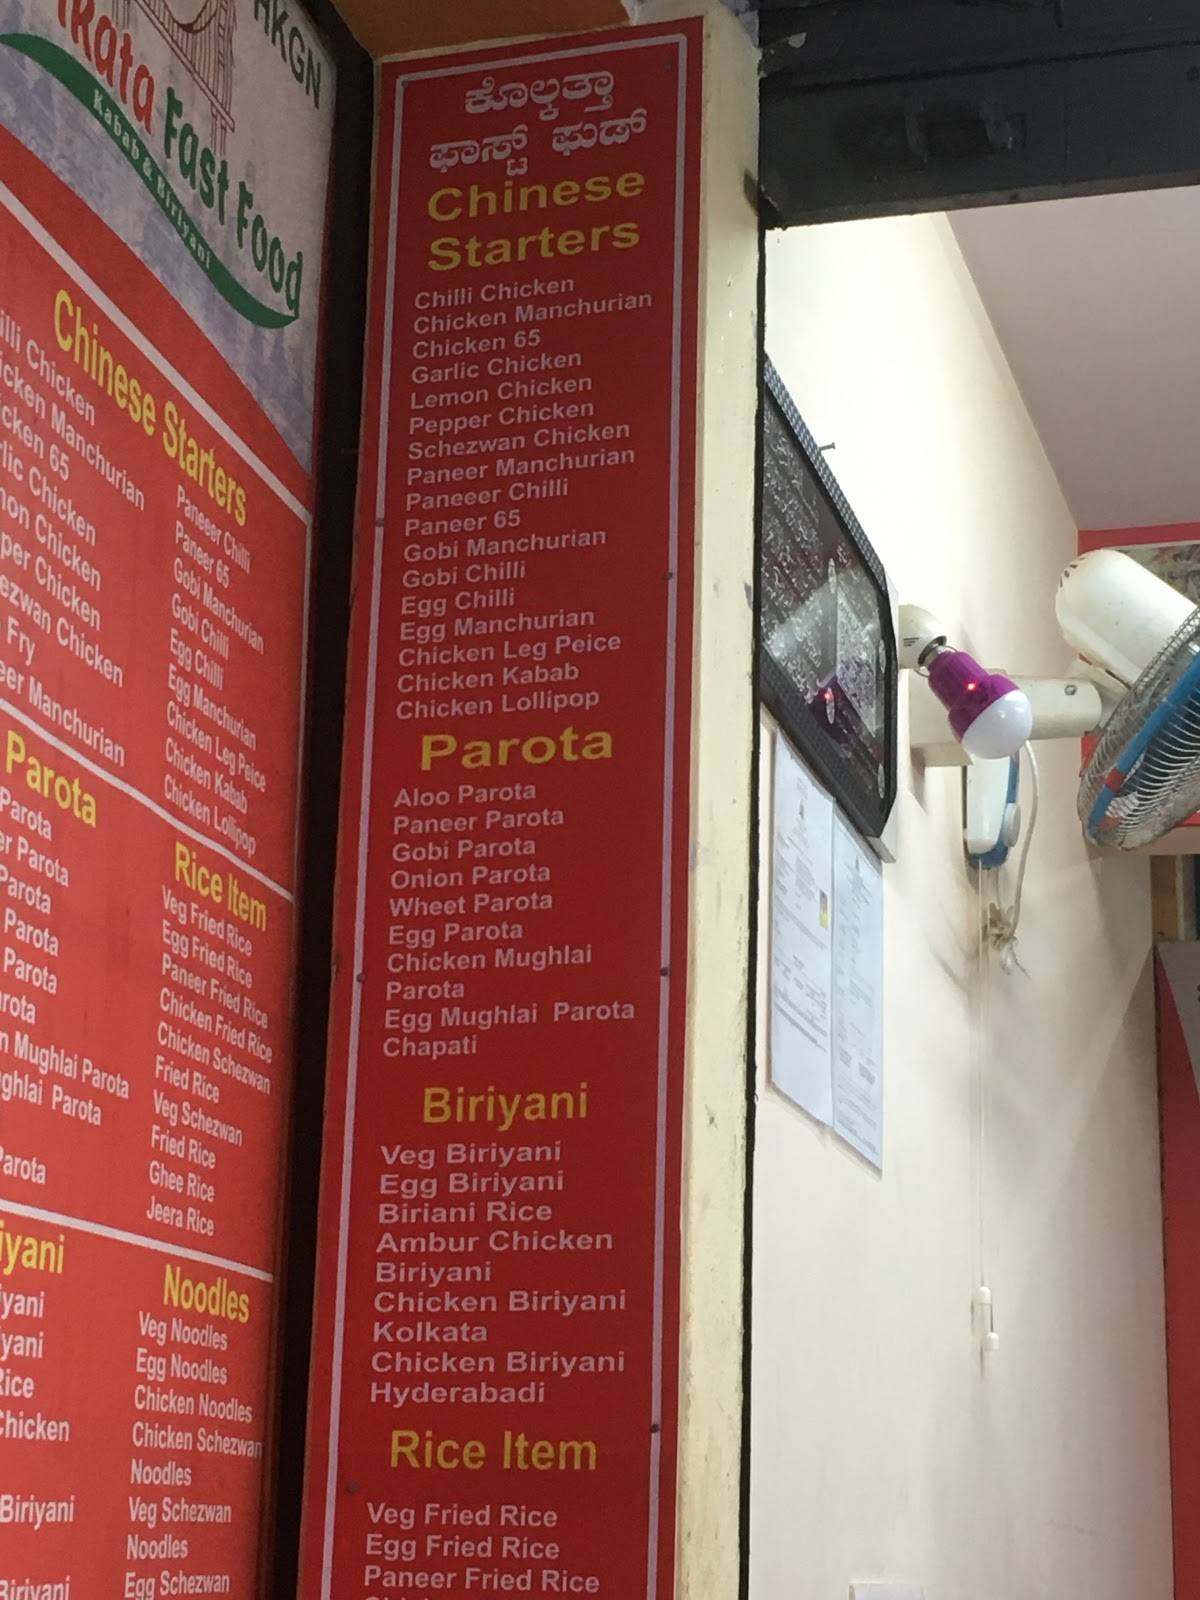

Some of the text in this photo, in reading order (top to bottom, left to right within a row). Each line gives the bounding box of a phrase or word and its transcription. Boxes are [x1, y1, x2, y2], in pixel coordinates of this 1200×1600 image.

[164, 87, 302, 319] Fast Food
[428, 171, 645, 222] Chinese
[428, 221, 640, 271] Starters
[414, 279, 574, 309] Chilli Chicken
[413, 293, 652, 334] Chicken Manchurian
[412, 329, 541, 359] Chicken 65
[27, 340, 95, 426] Chicken
[411, 353, 582, 384] Garlic Chicken
[54, 289, 246, 526] Chinese Starters
[411, 377, 592, 410] Lemon Chicken
[410, 402, 594, 435] Pepper Chicken
[51, 405, 144, 511] Manchurian
[408, 424, 630, 460] Schezwan Chicken
[50, 444, 69, 481] 65
[407, 449, 635, 485] Paneer Manchurian
[29, 467, 95, 546] Chicken
[406, 480, 568, 511] Paneeer Chilli
[405, 509, 521, 536] Paneer 65
[35, 514, 100, 591] Chicken
[404, 530, 606, 562] Gobi Manchurian
[402, 561, 526, 588] Gobi Chilli
[35, 557, 100, 631] Chicken
[174, 558, 264, 654] Gobi Manchurian
[401, 587, 514, 617] Egg Chilli
[8, 617, 35, 666] Fry
[172, 593, 229, 660] Gobi Chilli
[400, 609, 594, 644] Egg Manchurian
[56, 617, 122, 688] Chicken
[171, 628, 223, 690] Egg Chilli
[399, 634, 621, 667] Chicken Leg Peice
[397, 664, 579, 693] Chicken Kabab
[29, 675, 125, 767] Manchurian
[396, 690, 599, 720] Chicken Lollipop
[166, 737, 211, 790] Chicken
[421, 726, 612, 771] Parota
[6, 730, 96, 828] Parota
[394, 783, 536, 807] Aloo Parota
[164, 774, 210, 826] Chicken
[393, 809, 564, 834] Paneer Parota
[17, 836, 69, 887] Parota
[392, 838, 535, 862] Gobi Parota
[175, 841, 266, 931] Rice Item
[391, 864, 550, 889] Onion Parota
[162, 884, 251, 957] Veg Fried Rice
[390, 893, 552, 917] Wheet Parota
[5, 908, 59, 957] Parota
[389, 922, 523, 948] Egg Parota
[4, 946, 57, 995] Parota
[162, 920, 252, 989] Egg Fried Rice
[388, 944, 592, 973] Chicken Mughlai
[386, 980, 465, 1000] Parota
[385, 1001, 635, 1033] Egg Mughlai Parota
[14, 1031, 129, 1099] Mughlai Parota
[383, 1034, 477, 1060] Chapati
[156, 1055, 219, 1103] Fried Rice
[52, 1084, 101, 1126] Parota
[424, 1081, 587, 1131] Biriyani
[152, 1125, 215, 1169] Fried Rice
[381, 1141, 561, 1169] Veg Biriyani
[150, 1161, 214, 1203] Ghee Rice
[380, 1171, 564, 1199] Egg Biriyani
[146, 1196, 214, 1236] Jeera Rice
[379, 1201, 552, 1224] Biriani Rice
[376, 1230, 612, 1253] Ambur Chicken
[376, 1261, 491, 1287] Biriyani
[163, 1263, 249, 1323] Noodles
[374, 1289, 625, 1316] Chicken Biriyani
[139, 1311, 227, 1351] Veg Noodles
[373, 1321, 487, 1342] Kolkata
[136, 1348, 227, 1385] Egg Noodles
[372, 1351, 624, 1377] Chicken Biriyani
[371, 1382, 545, 1408] Hyderabadi
[390, 1430, 597, 1471] Rice Item
[131, 1459, 192, 1486] Noodles
[0, 1494, 75, 1530] Biriyani
[129, 1496, 231, 1528] Veg Schezwan
[368, 1502, 558, 1530] Veg Fried Rice
[127, 1534, 188, 1560] Noodles
[366, 1533, 559, 1562] Egg Fried Rice
[125, 1570, 229, 1600] Egg Schezwan
[365, 1565, 600, 1593] Paneer Fried Rice
